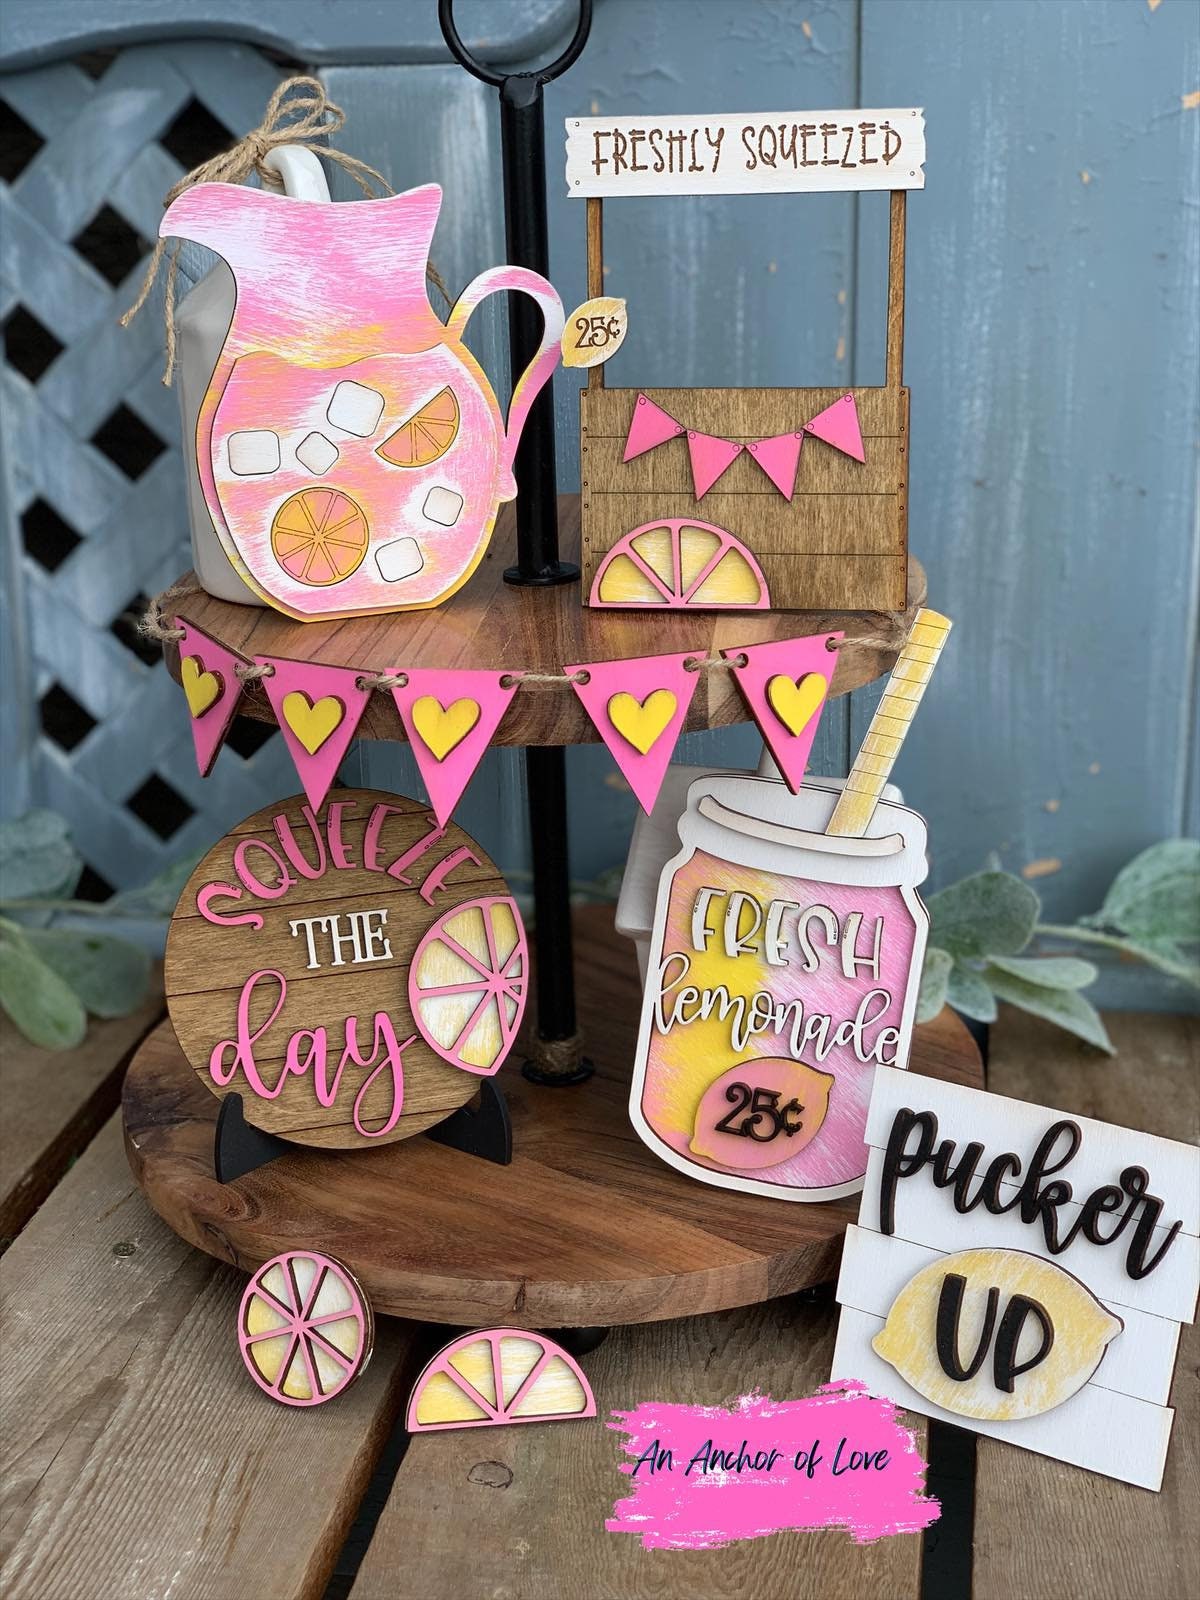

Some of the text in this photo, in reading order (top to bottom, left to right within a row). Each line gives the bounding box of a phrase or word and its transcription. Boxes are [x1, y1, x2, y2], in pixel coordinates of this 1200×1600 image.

[591, 121, 902, 176] FRESHLY SQUEEZED
[196, 801, 482, 930] SQUEEZE
[288, 909, 394, 969] THE
[691, 886, 884, 980] FRESH
[209, 969, 418, 1137] day
[650, 952, 901, 1064] lemonade
[880, 1107, 1184, 1281] pucker
[936, 1272, 1055, 1394] UP
